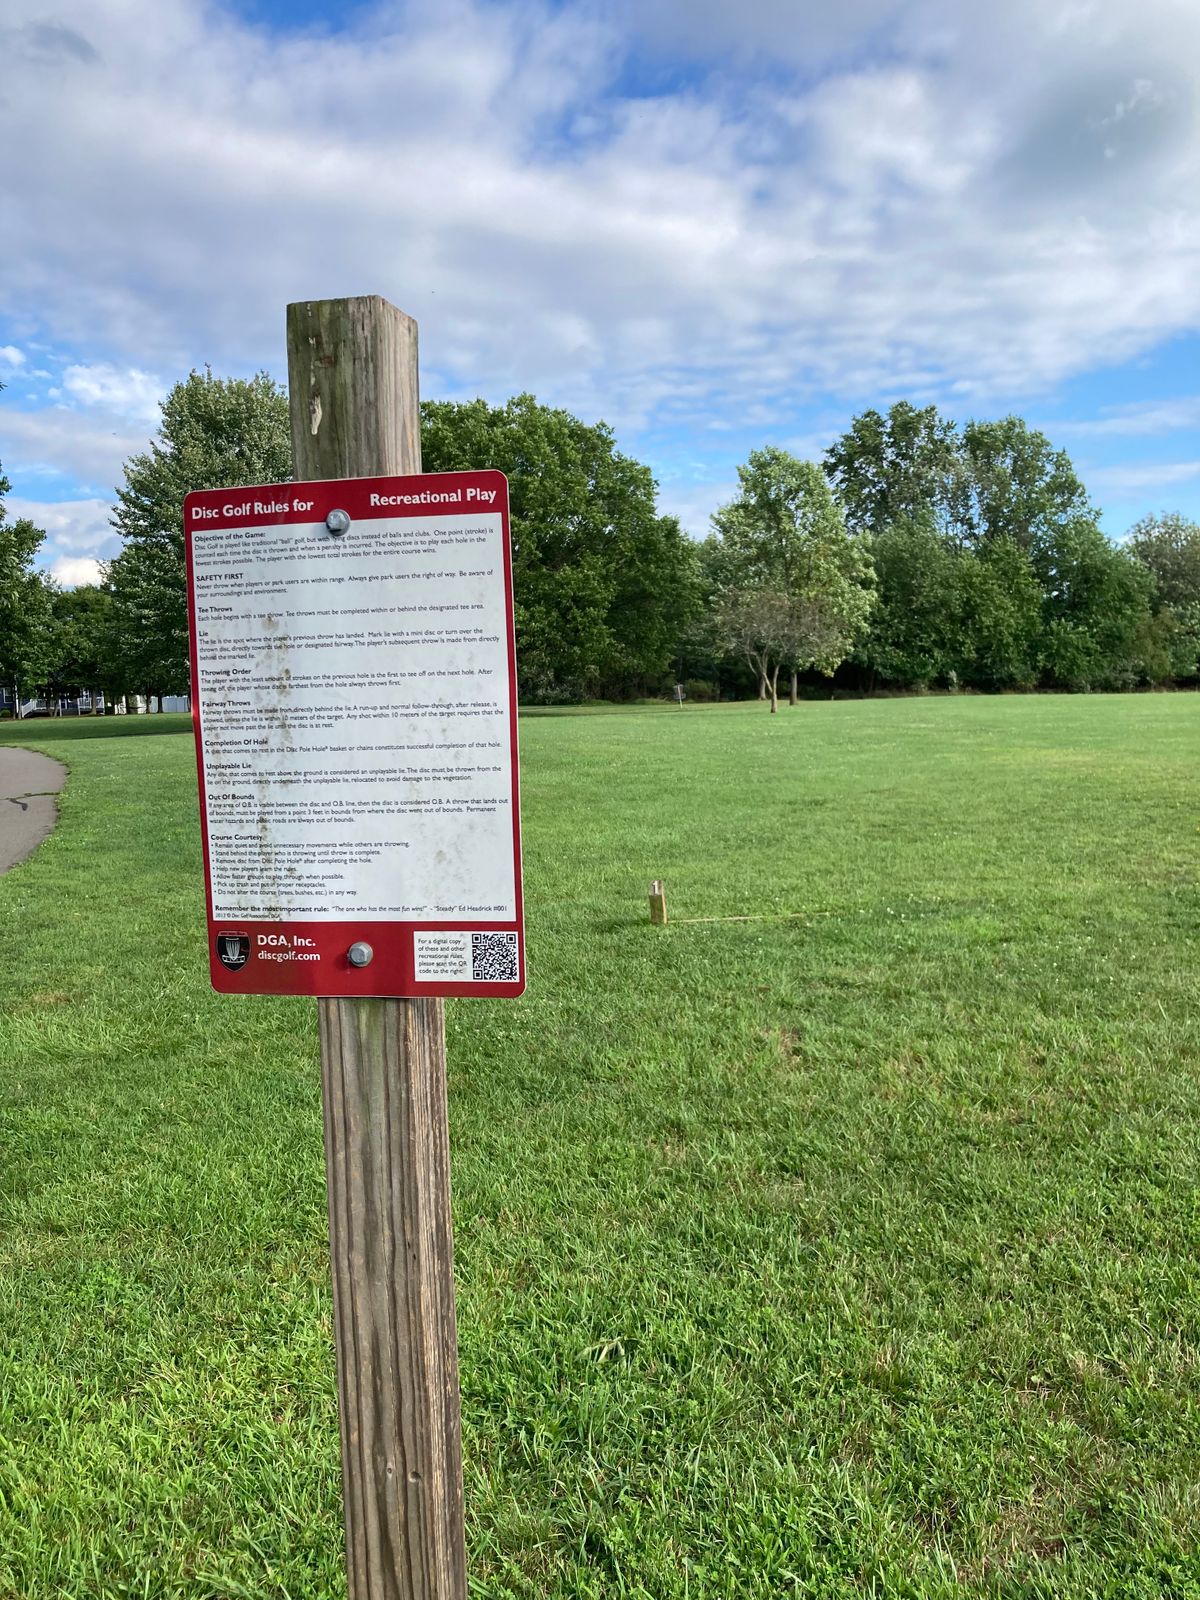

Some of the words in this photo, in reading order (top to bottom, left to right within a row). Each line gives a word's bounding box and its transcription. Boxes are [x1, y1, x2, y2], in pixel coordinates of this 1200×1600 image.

[192, 507, 219, 519] Disc
[222, 503, 251, 516] Golf
[254, 502, 290, 514] Rules
[292, 499, 314, 511] for
[370, 489, 462, 506] Recreational
[466, 488, 496, 504] Play
[465, 528, 487, 536] (stroke)
[194, 534, 224, 543] Objective
[387, 540, 412, 548] objective
[340, 608, 370, 616] completed
[429, 604, 459, 613] designated
[201, 669, 230, 677] Throwing
[202, 701, 226, 709] Fairway
[205, 740, 242, 748] Completion
[206, 763, 240, 771] Unplayable
[652, 880, 658, 894] 1
[257, 934, 292, 948] DGA,
[294, 935, 316, 946] Inc.
[258, 950, 320, 962] discgolf.com
